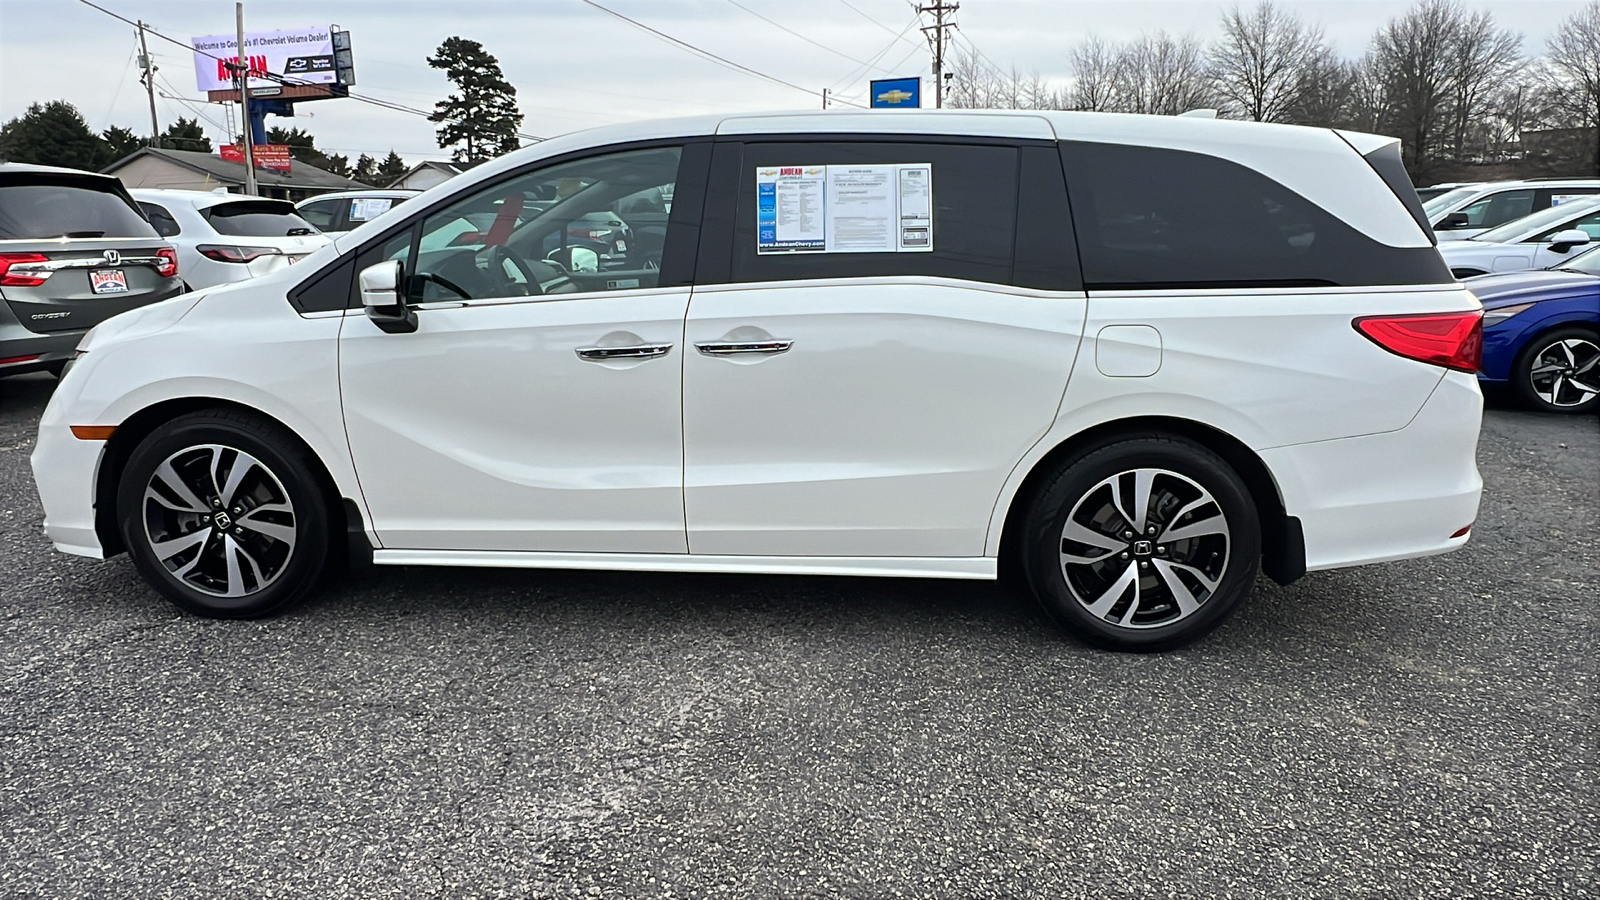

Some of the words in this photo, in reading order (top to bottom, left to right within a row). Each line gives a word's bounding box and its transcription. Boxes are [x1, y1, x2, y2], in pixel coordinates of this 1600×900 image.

[195, 42, 219, 51] Welcome
[227, 38, 252, 49] Geoa's
[253, 38, 259, 46] #1
[260, 36, 286, 46] Chevrolet
[287, 34, 308, 44] Volume
[309, 33, 329, 42] Dealer!
[217, 55, 267, 81] ANAN
[780, 168, 803, 176] ANDEAN
[94, 273, 125, 286] ANDEAN
[31, 311, 71, 320] ODYSSEY
